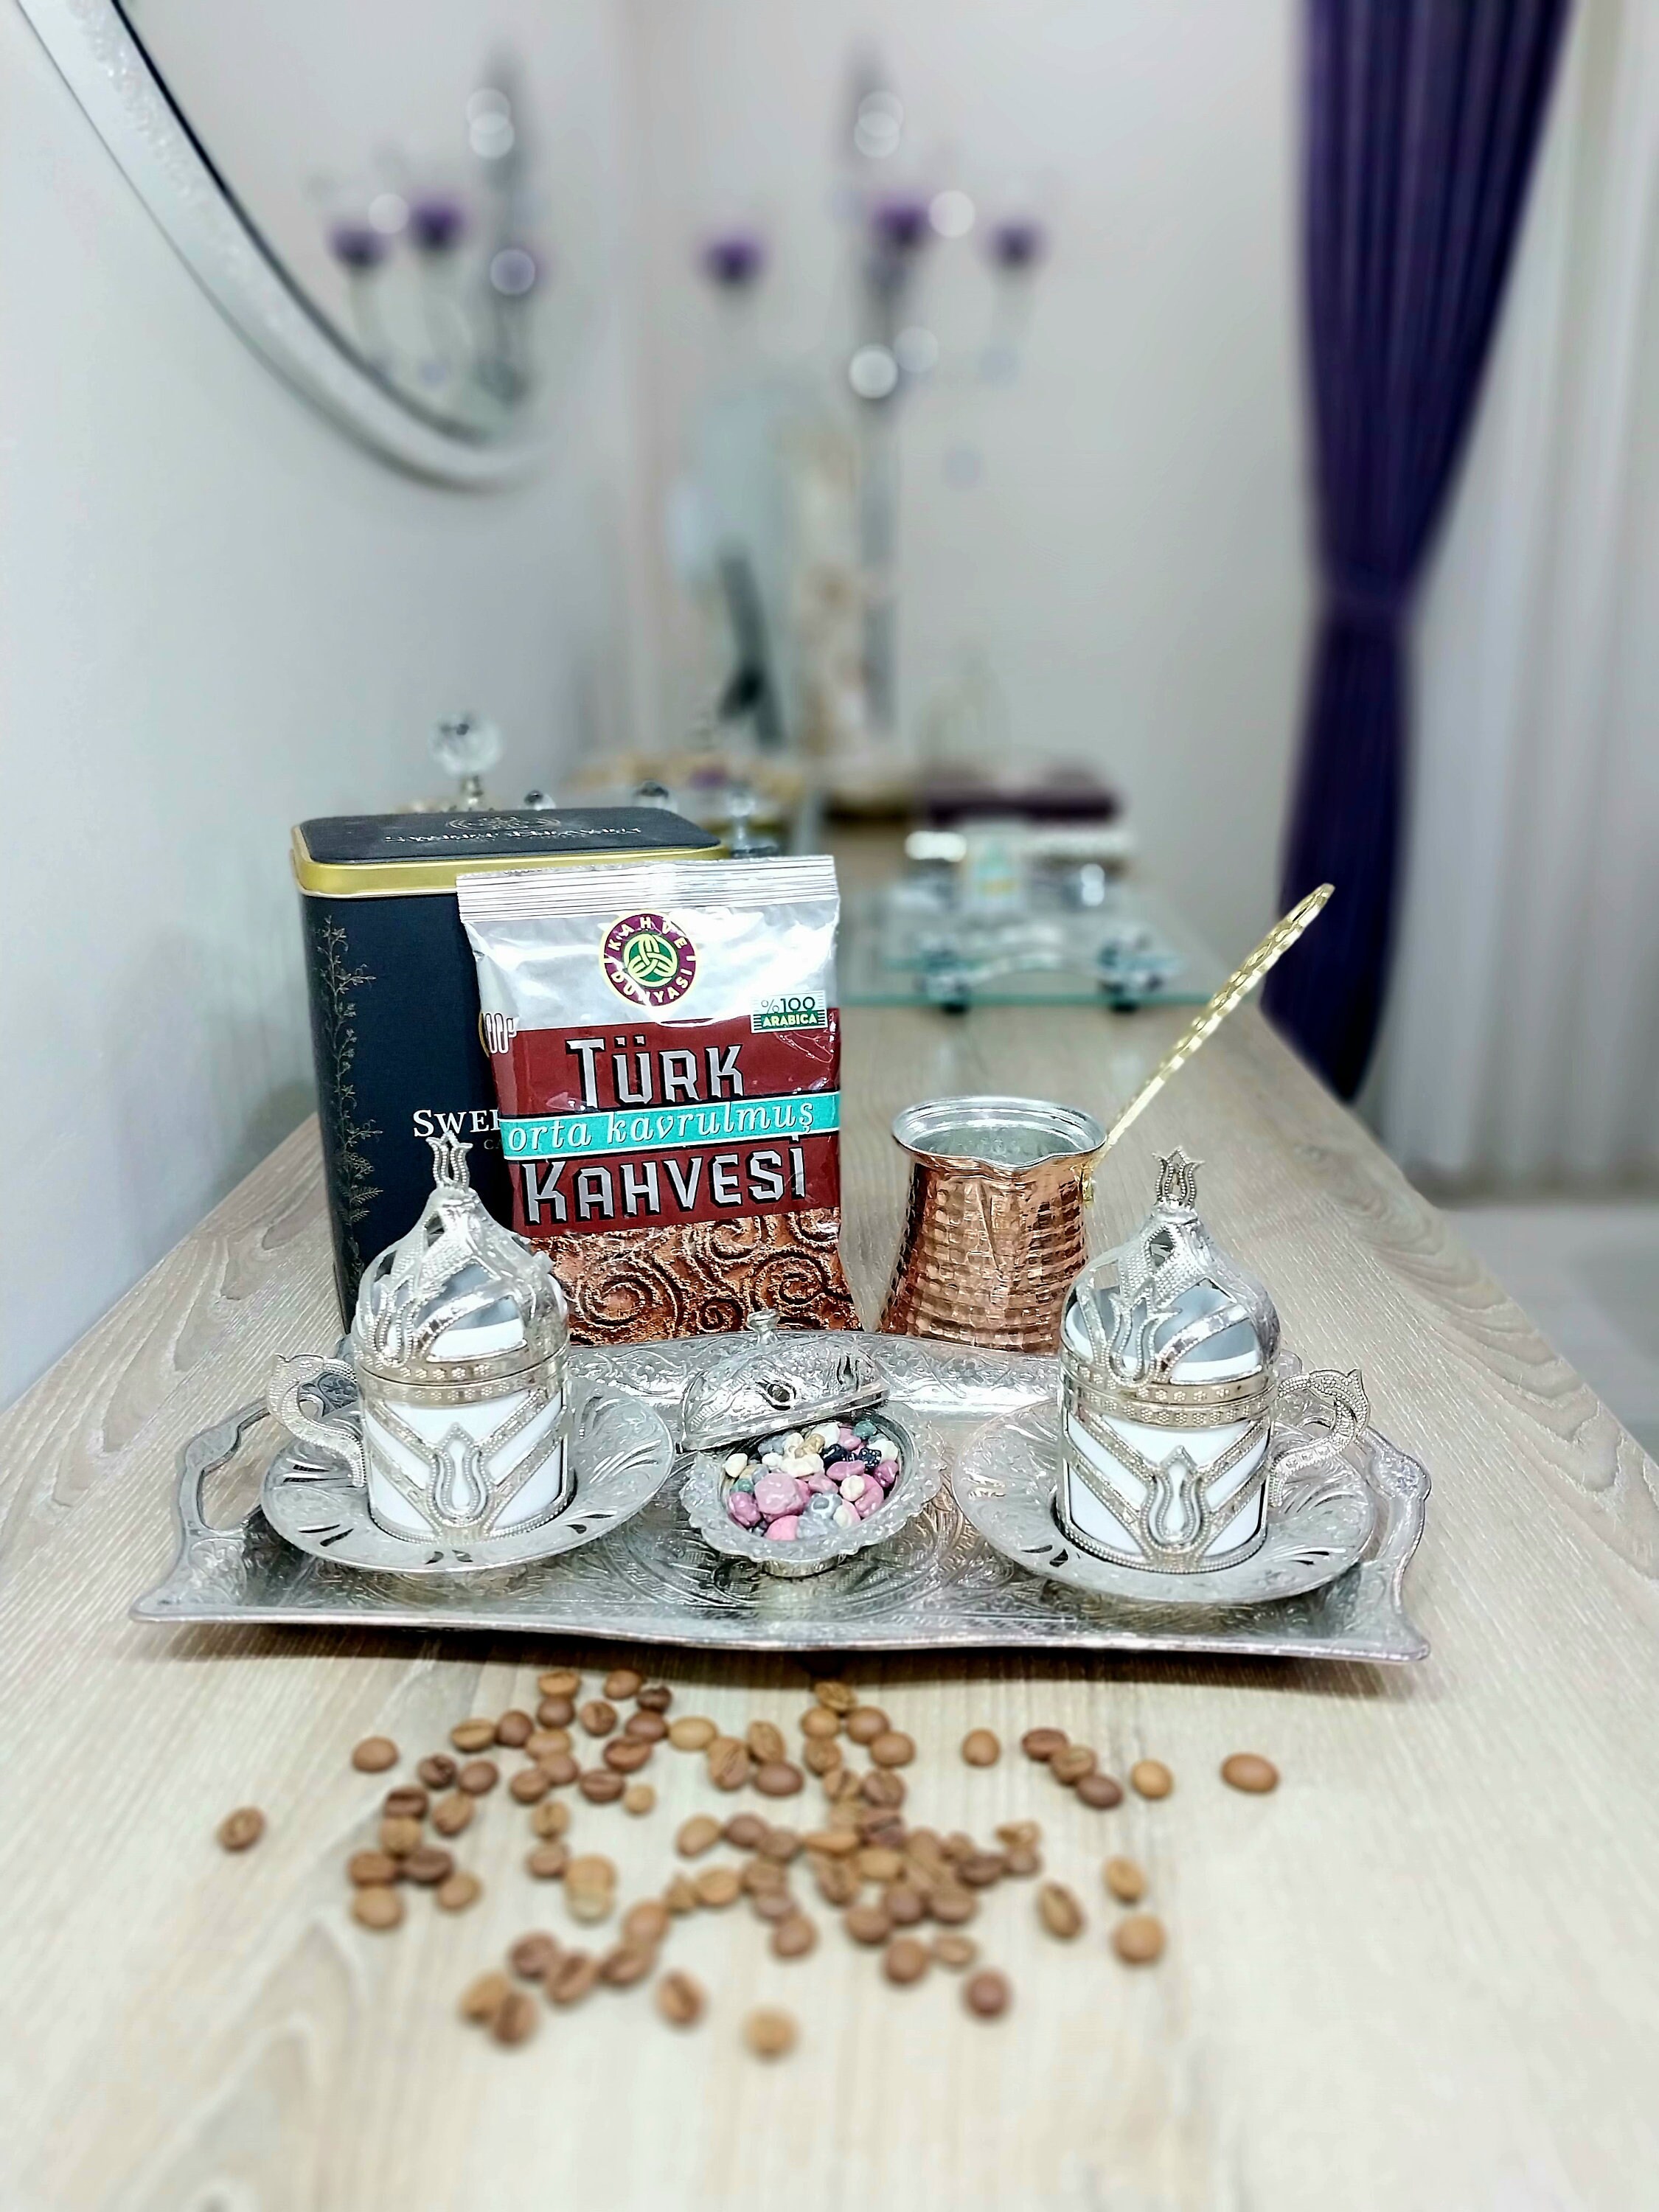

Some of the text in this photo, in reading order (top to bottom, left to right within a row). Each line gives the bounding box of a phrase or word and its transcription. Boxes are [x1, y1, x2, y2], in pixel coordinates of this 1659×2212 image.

[608, 917, 687, 951] KAHVE
[761, 996, 815, 1014] %100
[762, 1013, 818, 1027] ARABICA
[484, 1012, 518, 1054] 00g
[566, 1035, 745, 1110] TÜRK
[508, 1101, 815, 1152] orta kavrulmuş
[521, 1134, 806, 1225] KAHVESİ
